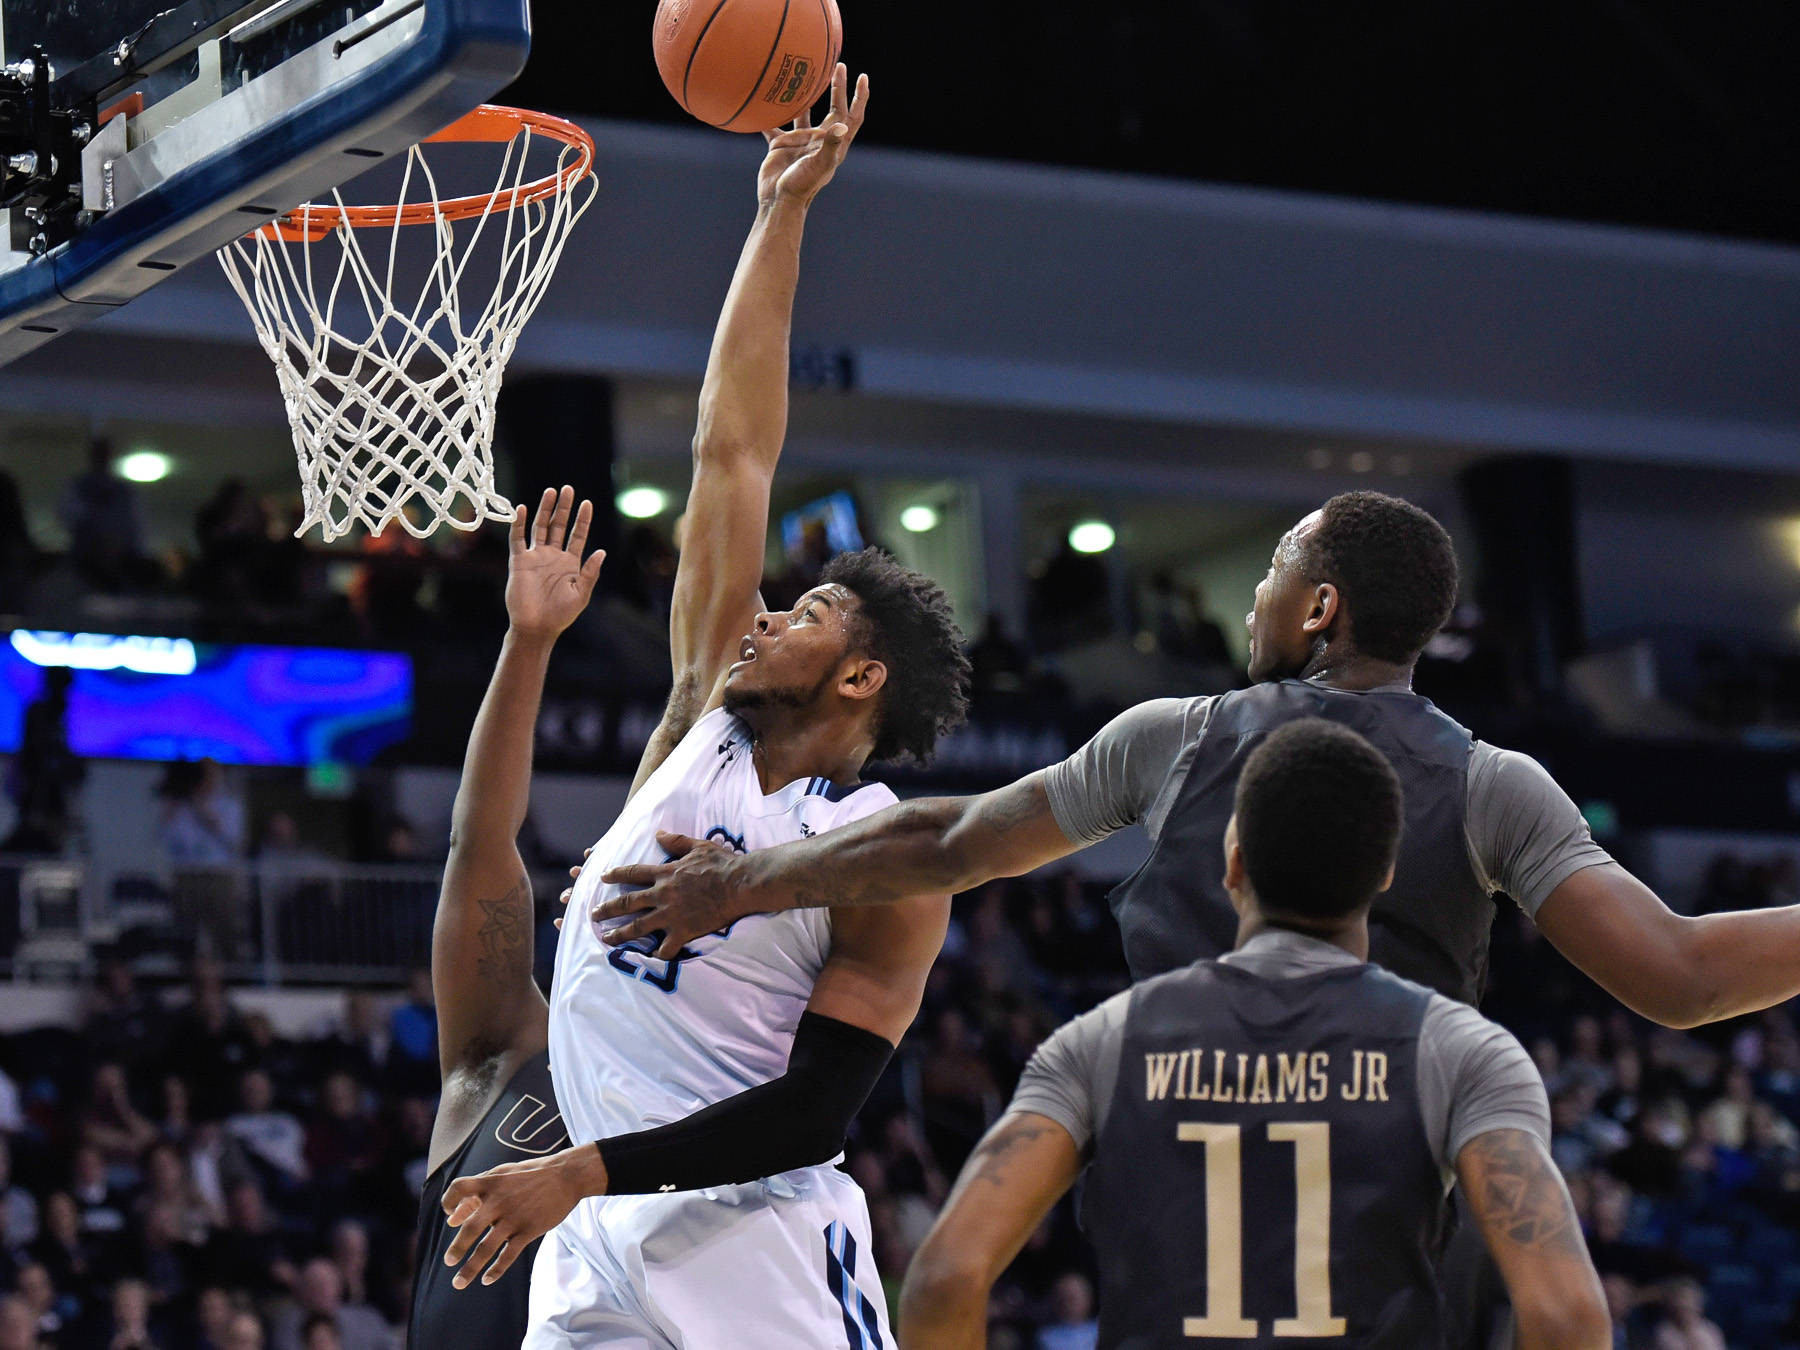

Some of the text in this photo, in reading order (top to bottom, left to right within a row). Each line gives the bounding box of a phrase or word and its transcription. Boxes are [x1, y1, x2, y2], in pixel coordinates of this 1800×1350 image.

[1145, 1049, 1390, 1104] WILLIAMS JR
[1177, 1121, 1347, 1339] 11
